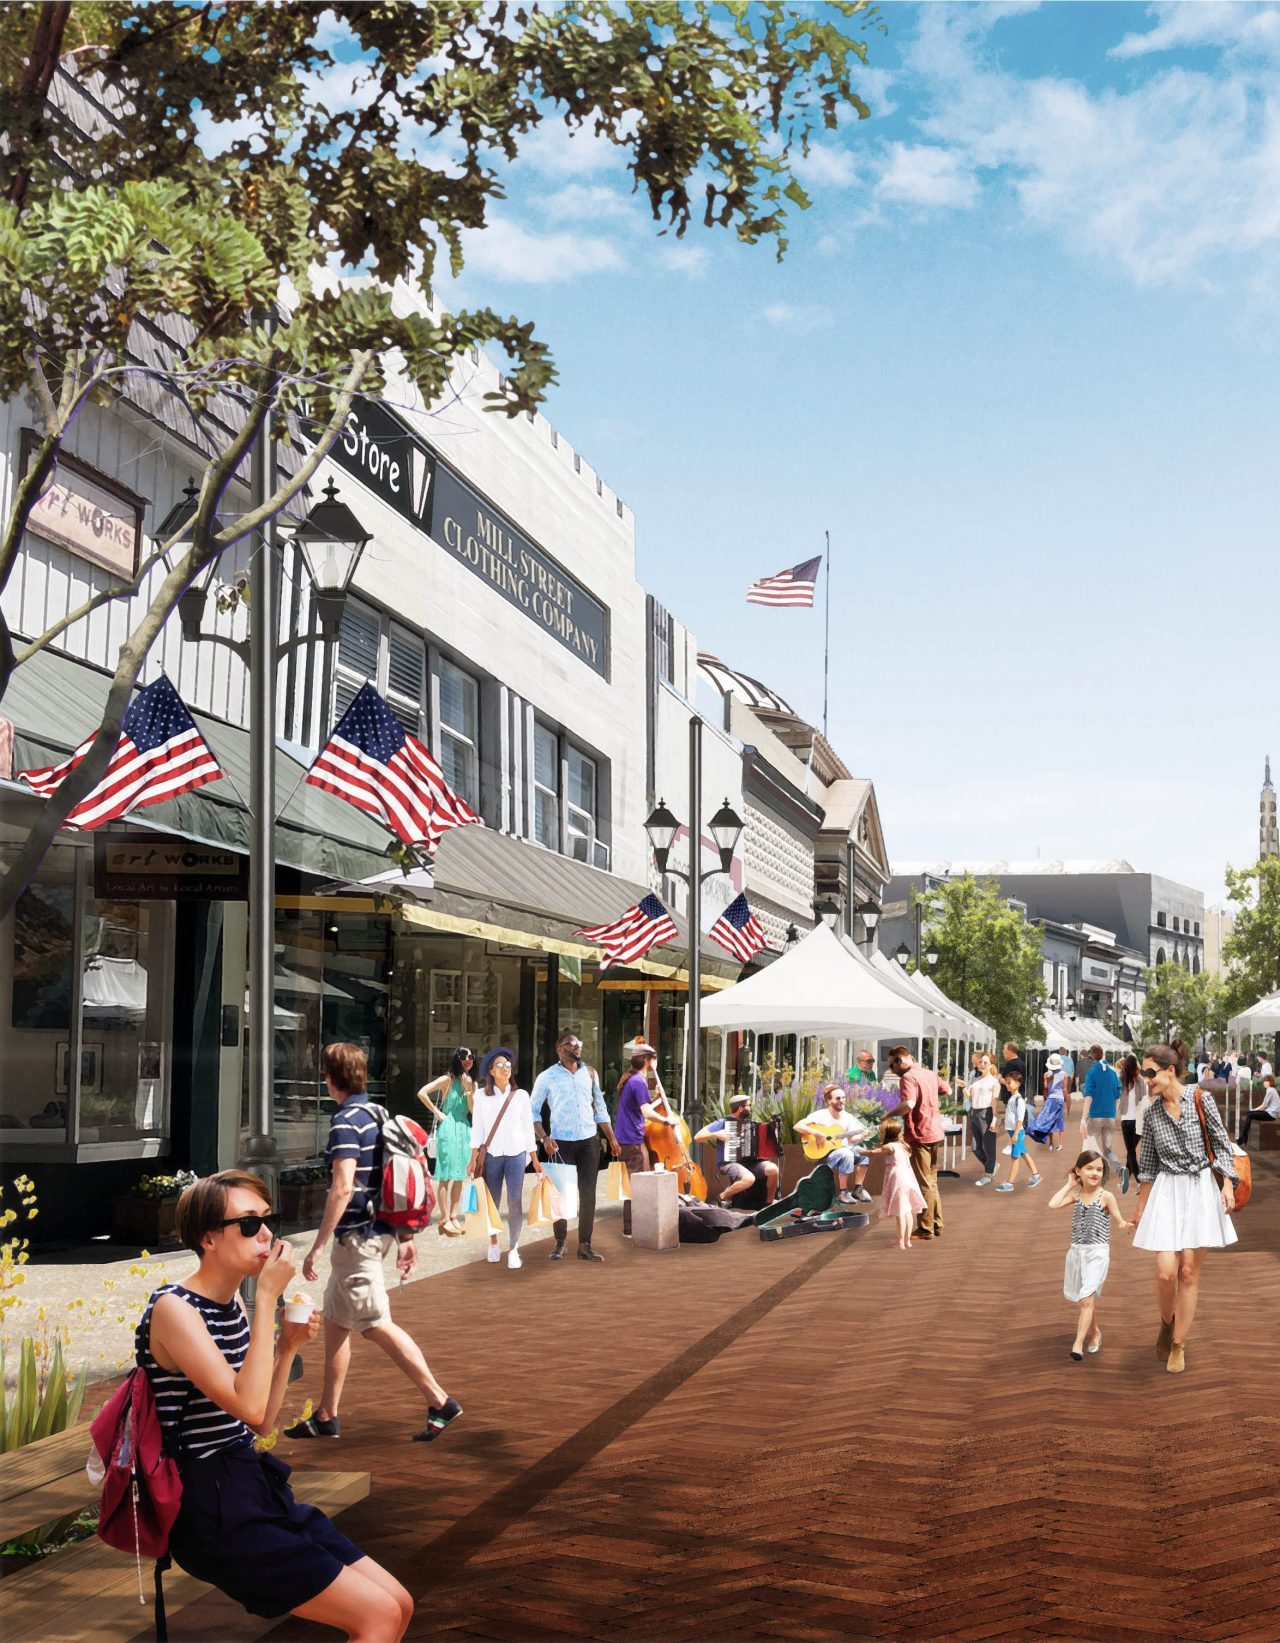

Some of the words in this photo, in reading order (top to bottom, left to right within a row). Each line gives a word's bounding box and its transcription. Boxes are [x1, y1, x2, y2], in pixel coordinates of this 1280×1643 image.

[343, 412, 400, 493] Store
[443, 516, 529, 608] CLOTHING
[532, 591, 599, 664] COMPANY
[476, 510, 518, 568] MILL
[520, 549, 574, 615] STREET
[112, 848, 159, 866] art
